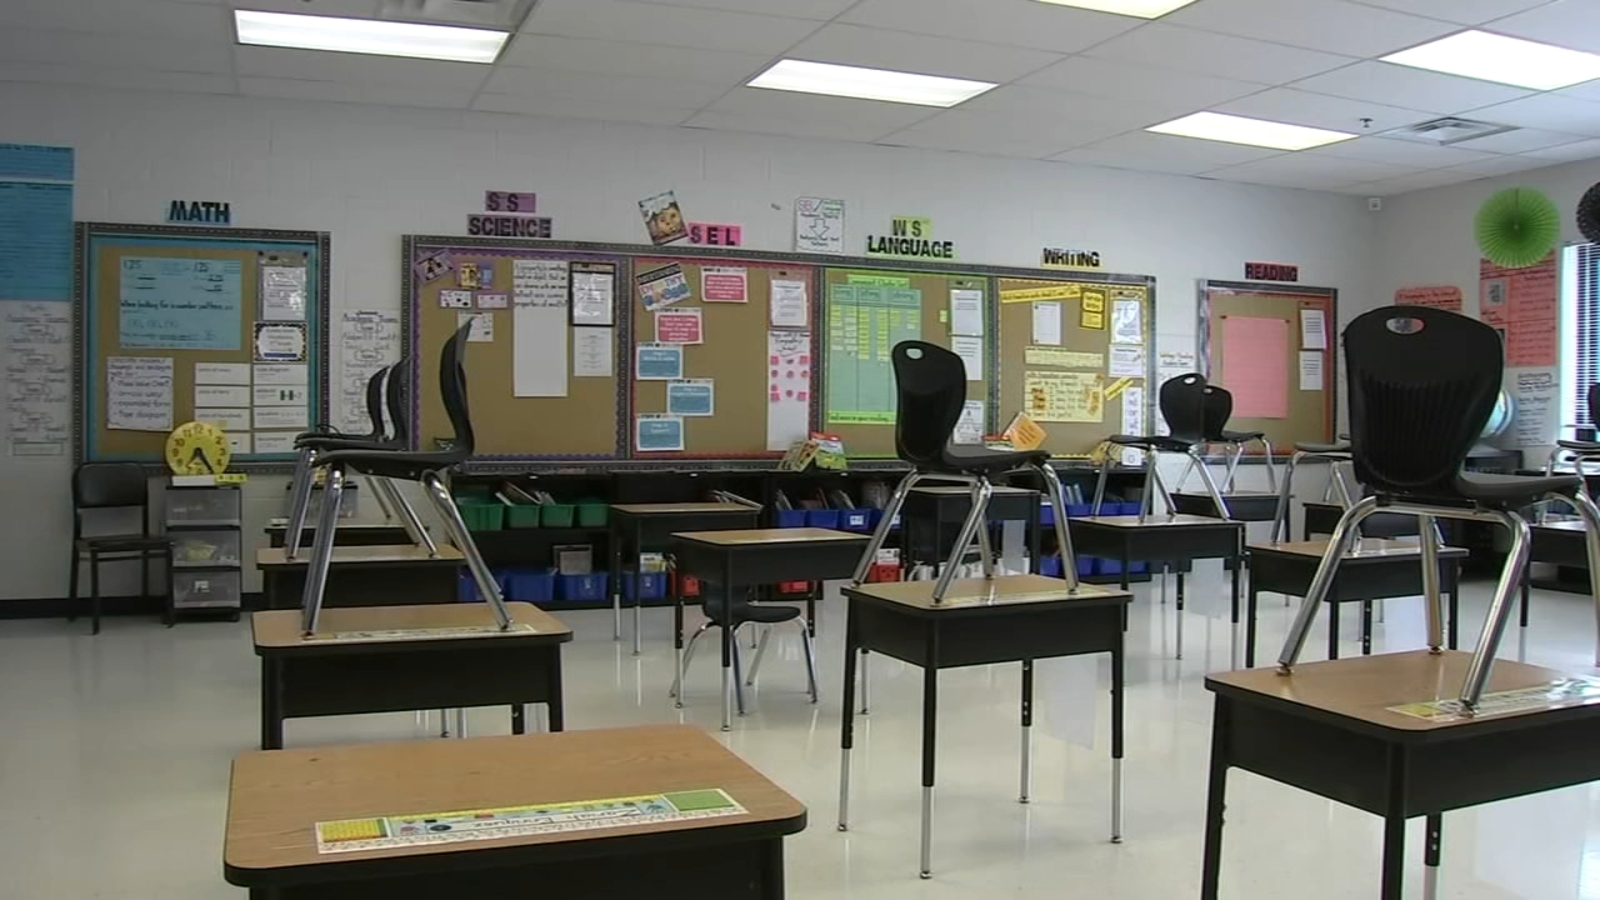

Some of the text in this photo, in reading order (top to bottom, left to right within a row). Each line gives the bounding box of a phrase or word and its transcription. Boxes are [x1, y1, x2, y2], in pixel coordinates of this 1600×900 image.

[169, 200, 231, 223] MATH
[468, 217, 551, 238] SCIENCE
[867, 235, 954, 258] LANGUAGE
[1043, 247, 1100, 267] WRITING
[1245, 262, 1298, 282] READING
[193, 423, 204, 434] 12
[173, 438, 186, 447] 10
